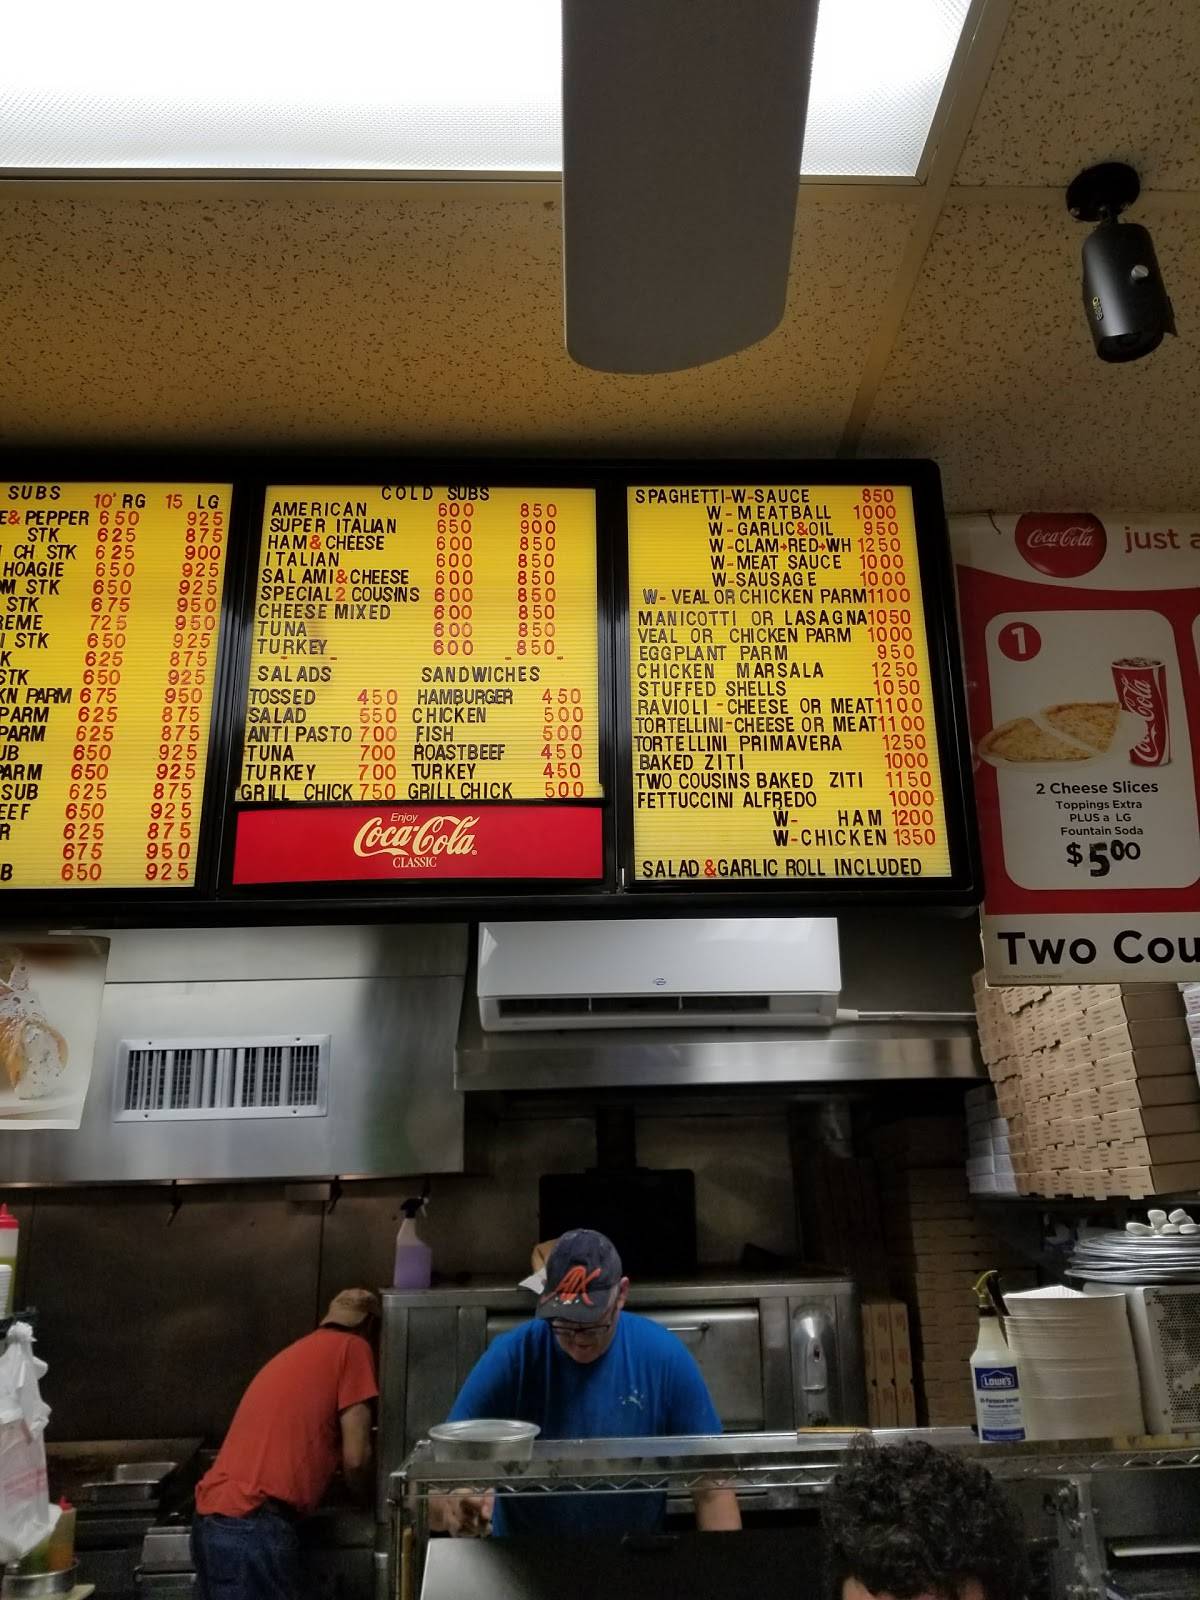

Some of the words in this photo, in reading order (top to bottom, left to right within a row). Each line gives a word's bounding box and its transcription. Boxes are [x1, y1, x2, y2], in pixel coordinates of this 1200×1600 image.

[8, 485, 61, 500] SUBS
[381, 487, 433, 500] COLD
[448, 487, 489, 500] SUBS
[862, 489, 894, 501] 850
[122, 494, 146, 508] RG
[166, 494, 183, 508] 15
[197, 494, 219, 508] LG
[271, 502, 367, 517] AMERICAN
[439, 504, 474, 517] 600
[521, 504, 557, 517] 850
[853, 506, 896, 519] 1000
[25, 510, 89, 525] PEPPER
[100, 511, 139, 525] 650
[187, 511, 223, 525] 925
[270, 519, 325, 533] SUPER
[336, 519, 396, 533] ITALIAN
[437, 520, 471, 533] 650
[521, 520, 556, 534] 900
[864, 522, 898, 535] 950
[28, 528, 59, 542] STK
[97, 528, 135, 542] 625
[186, 528, 223, 542] 875
[1124, 526, 1180, 553] just
[14, 545, 34, 559] CH
[47, 545, 77, 560] STK
[96, 545, 134, 559] 625
[185, 545, 220, 560] 900
[858, 538, 900, 552] 1250
[266, 553, 339, 567] ITALIAN
[436, 554, 473, 567] 600
[518, 554, 554, 567] 850
[788, 556, 841, 569] SAUCE
[859, 555, 903, 569] 1000
[4, 562, 64, 577] HOAGIE
[860, 572, 905, 586] 1000
[26, 580, 60, 595] STK
[352, 587, 419, 602] COUSINS
[672, 590, 709, 604] VEAL
[714, 590, 735, 604] OR
[740, 590, 812, 604] CHICKEN
[821, 589, 867, 604] PARM
[868, 589, 910, 602] 1100
[7, 597, 40, 612] STK
[91, 598, 130, 612] 675
[177, 598, 216, 612] 950
[258, 605, 326, 619] CHEESE
[334, 605, 390, 619] MIXED
[91, 615, 127, 630] 725
[175, 615, 215, 630] 950
[639, 611, 736, 626] MANICOTTI
[752, 612, 773, 626] OR
[785, 610, 867, 626] LASAGNA
[868, 610, 910, 624] 1050
[258, 622, 307, 636] TUNA
[433, 622, 472, 637] 600
[518, 623, 555, 637] 850
[638, 628, 678, 643] VEAL
[691, 628, 712, 642] OR
[730, 628, 798, 642] CHICKEN
[807, 628, 851, 642] PARM
[868, 627, 912, 642] 1000
[15, 633, 49, 648] STK
[257, 640, 328, 654] TURKEY
[1011, 627, 1026, 655] 1
[640, 646, 727, 660] EGGPLANT
[740, 646, 788, 660] PARM
[878, 645, 914, 659] 950
[258, 666, 332, 682] SALADS
[422, 666, 540, 682] SANDWICHES
[638, 663, 714, 678] CHICKEN
[737, 662, 823, 678] MARSALA
[872, 662, 917, 677] 1250
[639, 681, 716, 697] STUFFED
[726, 681, 786, 696] SHELLS
[873, 680, 920, 695] 1050
[26, 688, 72, 703] PARM
[80, 688, 117, 703] 675
[165, 688, 202, 703] 950
[250, 689, 316, 705] TOSSED
[357, 689, 398, 704] 450
[418, 689, 513, 705] HAMBURGER
[542, 688, 581, 704] 450
[800, 699, 820, 714] OR
[832, 698, 874, 713] MEAT
[875, 698, 922, 713] 1100
[249, 708, 306, 723] SALAD
[360, 708, 397, 723] 550
[412, 708, 486, 723] CHICKEN
[544, 707, 583, 722] 500
[802, 717, 824, 732] OR
[834, 716, 877, 732] MEAT
[877, 716, 924, 731] 1100
[360, 726, 397, 742] 700
[416, 726, 454, 742] FISH
[543, 726, 581, 741] 500
[635, 736, 727, 752] TORTELLINI
[740, 735, 841, 751] PRIMAVERA
[882, 735, 926, 750] 1250
[248, 745, 294, 762] TUNA
[360, 745, 396, 760] 700
[414, 744, 505, 760] ROASTBEEF
[541, 744, 582, 760] 450
[640, 754, 693, 770] BAKED
[705, 754, 744, 770] ZITI
[885, 753, 928, 769] 1000
[246, 765, 316, 781] TURKEY
[359, 764, 396, 780] 700
[411, 764, 476, 780] TURKEY
[544, 763, 581, 779] 450
[636, 773, 672, 790] TWO
[679, 773, 749, 789] COUSINS
[757, 773, 813, 788] BAKED
[830, 772, 863, 788] ZITI
[886, 771, 931, 787] 1150
[1, 784, 38, 800] SUB
[69, 784, 106, 799] 625
[241, 785, 289, 801] GRILL
[304, 784, 352, 801] CHICK
[360, 784, 396, 801] 750
[408, 783, 456, 799] GRILL
[461, 783, 512, 799] CHICK
[545, 782, 584, 798] 500
[1036, 783, 1045, 794] 2
[1050, 782, 1108, 794] Cheese
[1113, 781, 1158, 793] Slices
[638, 792, 733, 808] FETTUCCINI
[743, 791, 817, 808] ALFREDO
[889, 790, 934, 807] 1000
[1056, 800, 1109, 810] Toppings
[1113, 800, 1142, 808] Extra
[391, 813, 418, 823] Enjoy
[838, 810, 882, 826] HAM
[891, 809, 933, 826] 1200
[1070, 814, 1100, 822] PLUS
[1116, 813, 1131, 821] LG
[893, 829, 936, 845] 1350
[1061, 826, 1111, 836] Fountain
[1115, 826, 1143, 835] Soda
[393, 857, 436, 868] CLASSIC
[643, 860, 699, 877] SALAD
[786, 859, 825, 875] ROLL
[835, 858, 921, 875] INCLUDED
[62, 863, 101, 880] 650
[146, 863, 188, 880] 925
[998, 932, 1097, 965] Two
